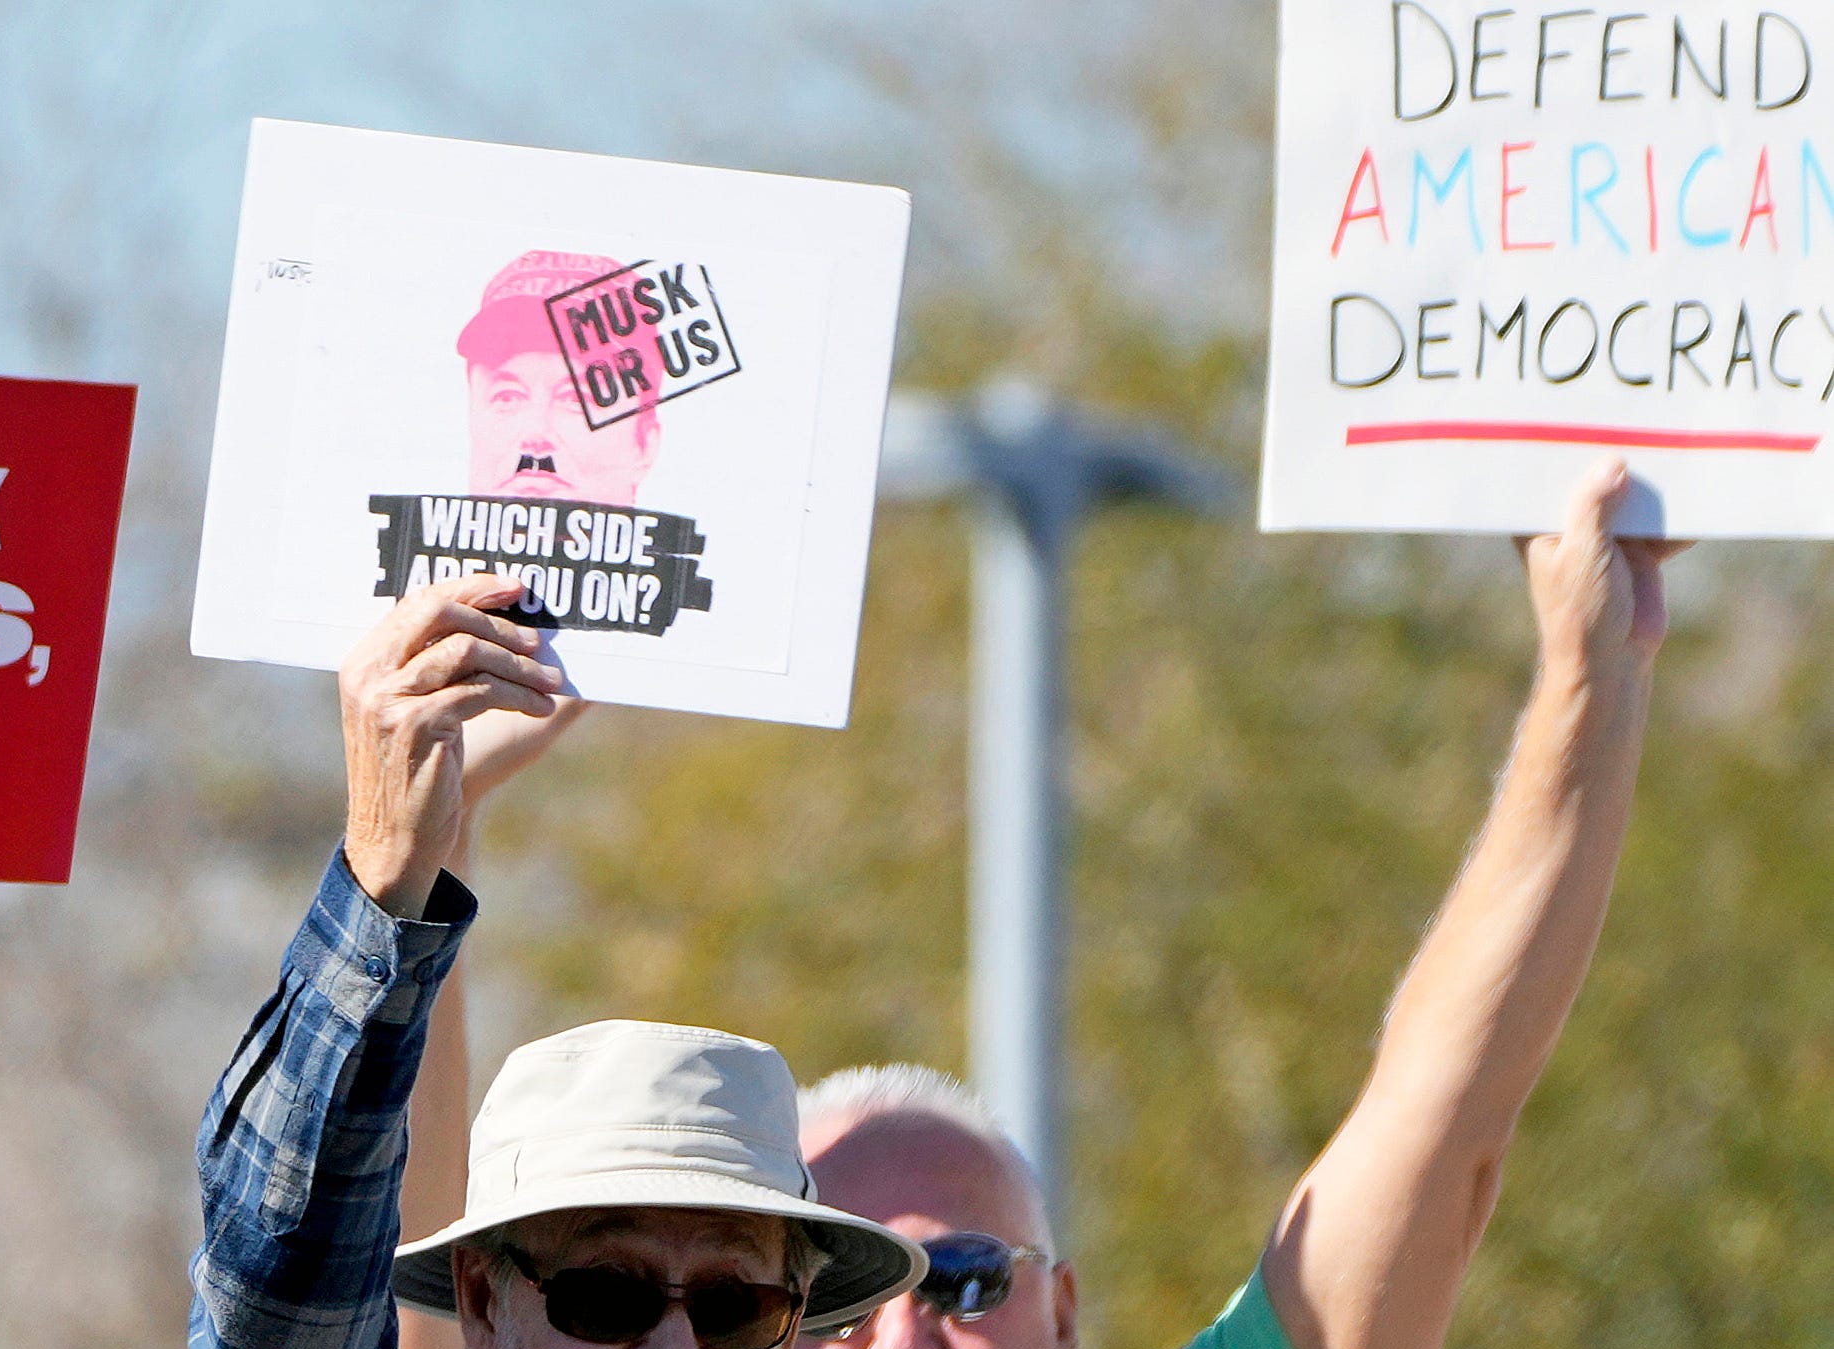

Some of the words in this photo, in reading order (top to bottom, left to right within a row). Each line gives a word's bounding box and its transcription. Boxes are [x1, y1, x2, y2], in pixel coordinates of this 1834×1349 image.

[1392, 0, 1813, 121] DEFEND
[1330, 137, 1834, 260] AMERICAN
[566, 262, 700, 352] MUSK
[585, 347, 653, 408] OR
[655, 318, 719, 379] US
[420, 495, 558, 558] WHICH
[563, 508, 659, 567] SIDE
[579, 569, 662, 626] ON?
